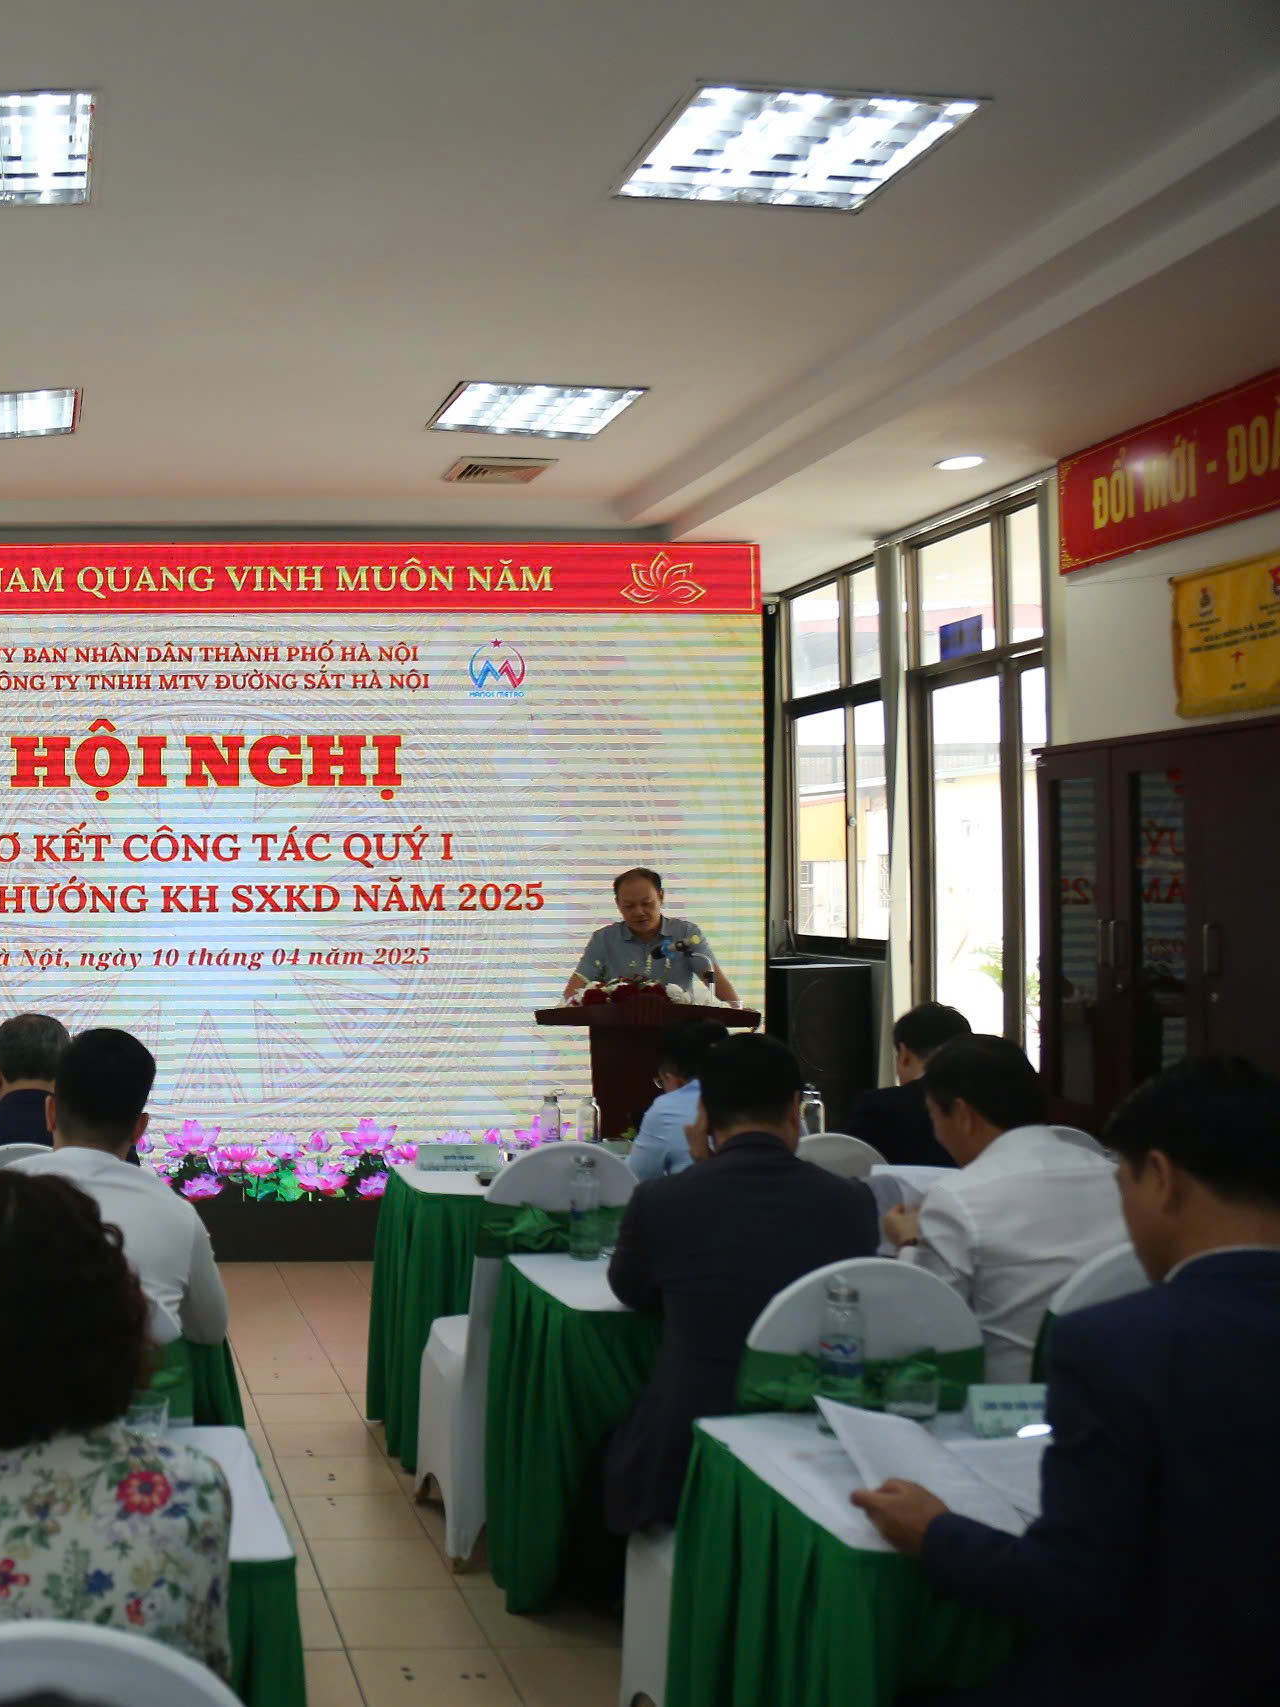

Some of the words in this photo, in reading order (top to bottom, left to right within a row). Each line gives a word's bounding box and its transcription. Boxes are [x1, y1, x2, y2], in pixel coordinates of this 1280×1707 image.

[1092, 447, 1136, 530] ĐỔI
[1143, 434, 1197, 512] MỚI
[76, 565, 215, 599] QUANG
[224, 565, 324, 592] VINH
[335, 557, 455, 592] MUÔN
[466, 559, 553, 592] NĂM
[23, 647, 68, 663] BAN
[75, 642, 139, 663] NHÂN
[146, 642, 193, 663] DÂN
[199, 643, 279, 663] THÀNH
[287, 638, 335, 663] PHỐ
[340, 643, 372, 663] HÀ
[378, 642, 419, 667] NỘI
[51, 674, 81, 690] TY
[85, 674, 151, 690] TNHH
[159, 673, 209, 689] MTV
[215, 670, 298, 690] ĐƯỜNG
[303, 665, 345, 689] SẮT
[352, 670, 382, 689] HÀ
[389, 669, 430, 693] NỘI
[10, 718, 168, 802] HỘI
[185, 734, 403, 801] NGHỊ
[34, 821, 112, 863] KẾT
[122, 825, 241, 863] CÔNG
[251, 825, 331, 862] TÁC
[343, 824, 431, 869] QUÝ
[441, 832, 454, 861] I
[161, 884, 219, 913] KH
[232, 884, 341, 913] SXKD
[352, 876, 445, 912] NĂM
[458, 881, 545, 913] 2025
[23, 943, 70, 970] Nội,
[79, 948, 142, 972] ngày
[152, 948, 179, 967] 10
[188, 946, 263, 971] tháng
[271, 948, 300, 966] 04
[307, 948, 363, 966] năm
[373, 946, 431, 966] 2025
